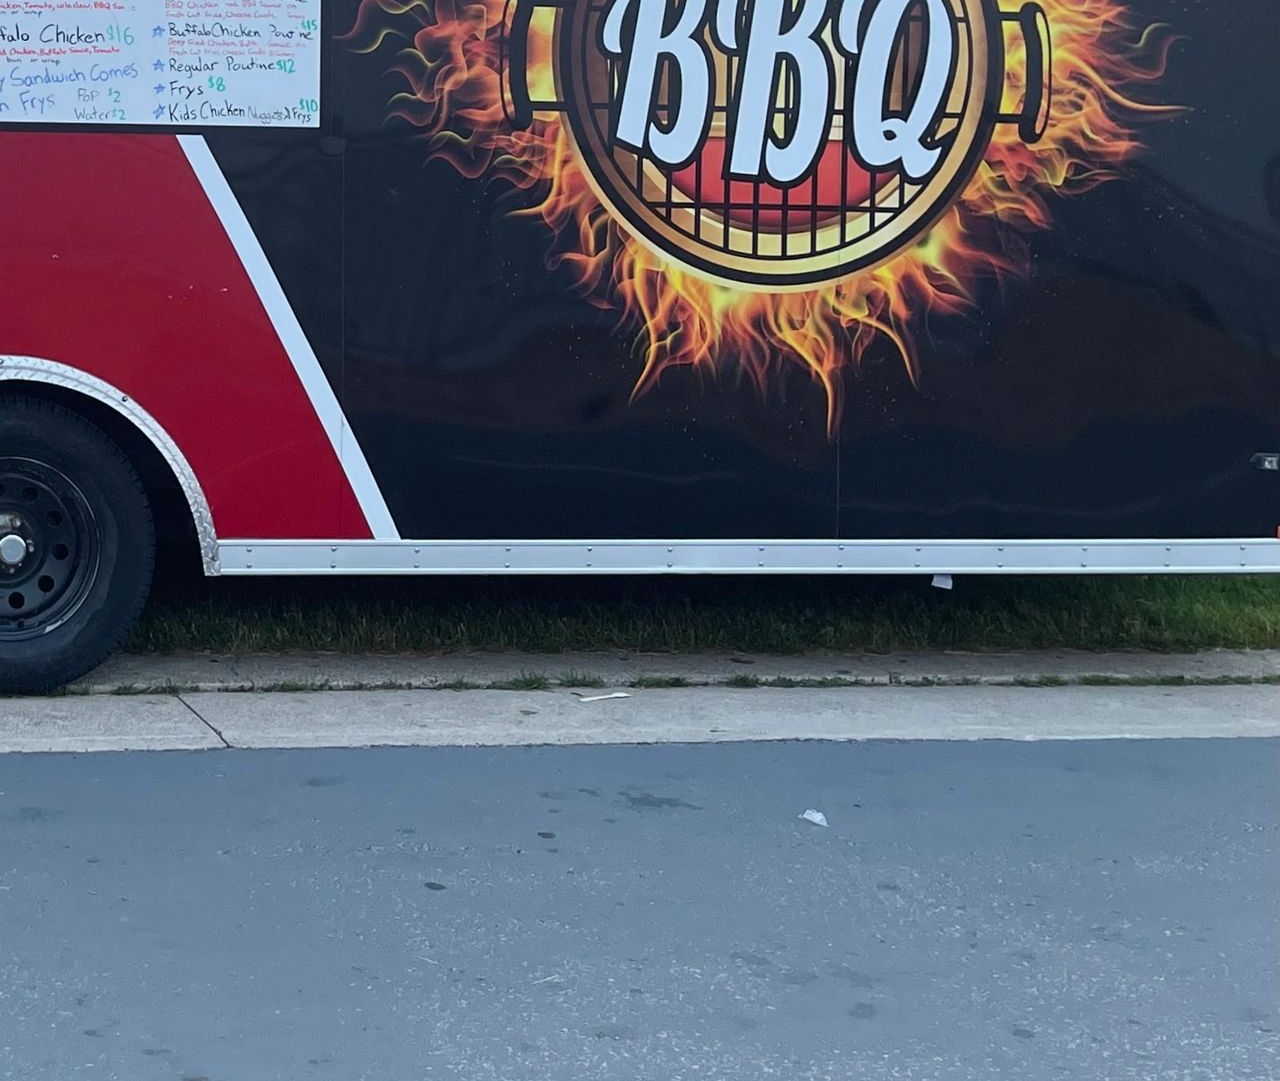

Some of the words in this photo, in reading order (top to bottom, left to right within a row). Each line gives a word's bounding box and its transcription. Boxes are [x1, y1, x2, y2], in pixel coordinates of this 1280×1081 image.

[39, 23, 106, 45] Chicken
[211, 21, 262, 38] Chicken
[269, 24, 314, 40] Poutne
[10, 66, 86, 87] Sandwich
[90, 62, 139, 82] Comes
[168, 57, 219, 78] Regular
[226, 55, 276, 72] Poutine
[276, 59, 297, 73] $12
[169, 80, 204, 100] Frys
[208, 75, 226, 92] $8
[19, 90, 56, 115] Frys
[74, 106, 110, 121] Water
[168, 103, 198, 122] Kids
[199, 99, 245, 120] Chicken
[299, 98, 318, 113] $10
